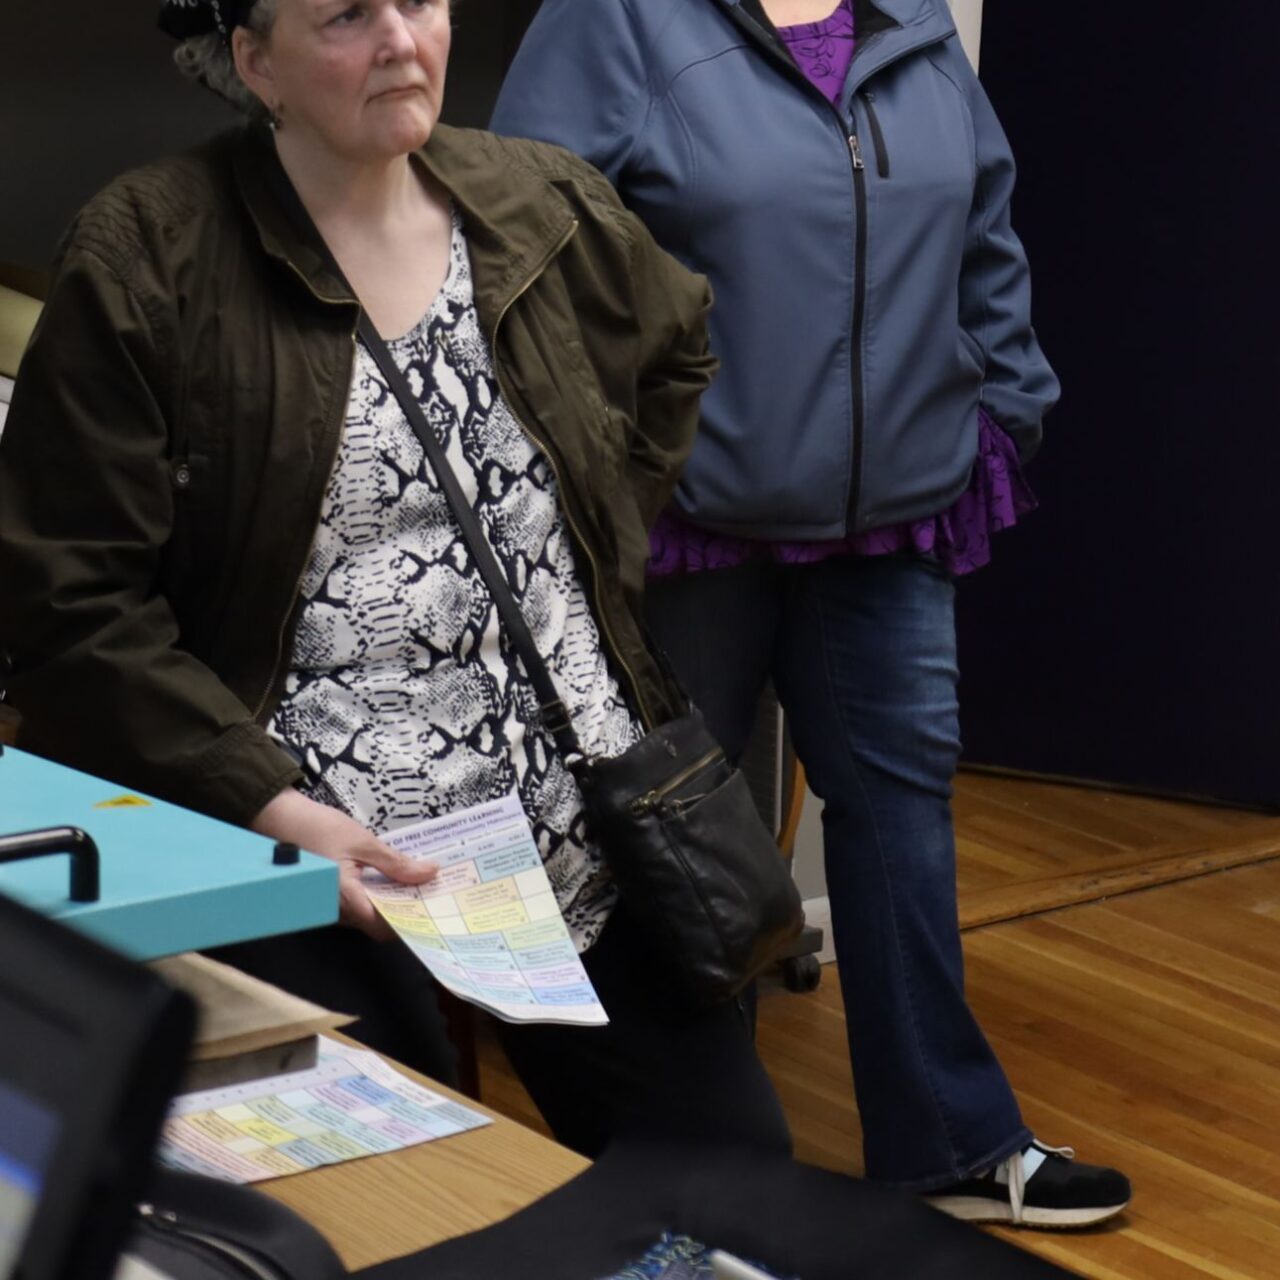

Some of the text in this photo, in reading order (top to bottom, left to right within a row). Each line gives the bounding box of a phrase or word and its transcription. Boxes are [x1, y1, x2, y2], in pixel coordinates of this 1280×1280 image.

[404, 832, 422, 843] FREE
[422, 817, 468, 837] COMMUNITY
[469, 807, 505, 823] LEARNING
